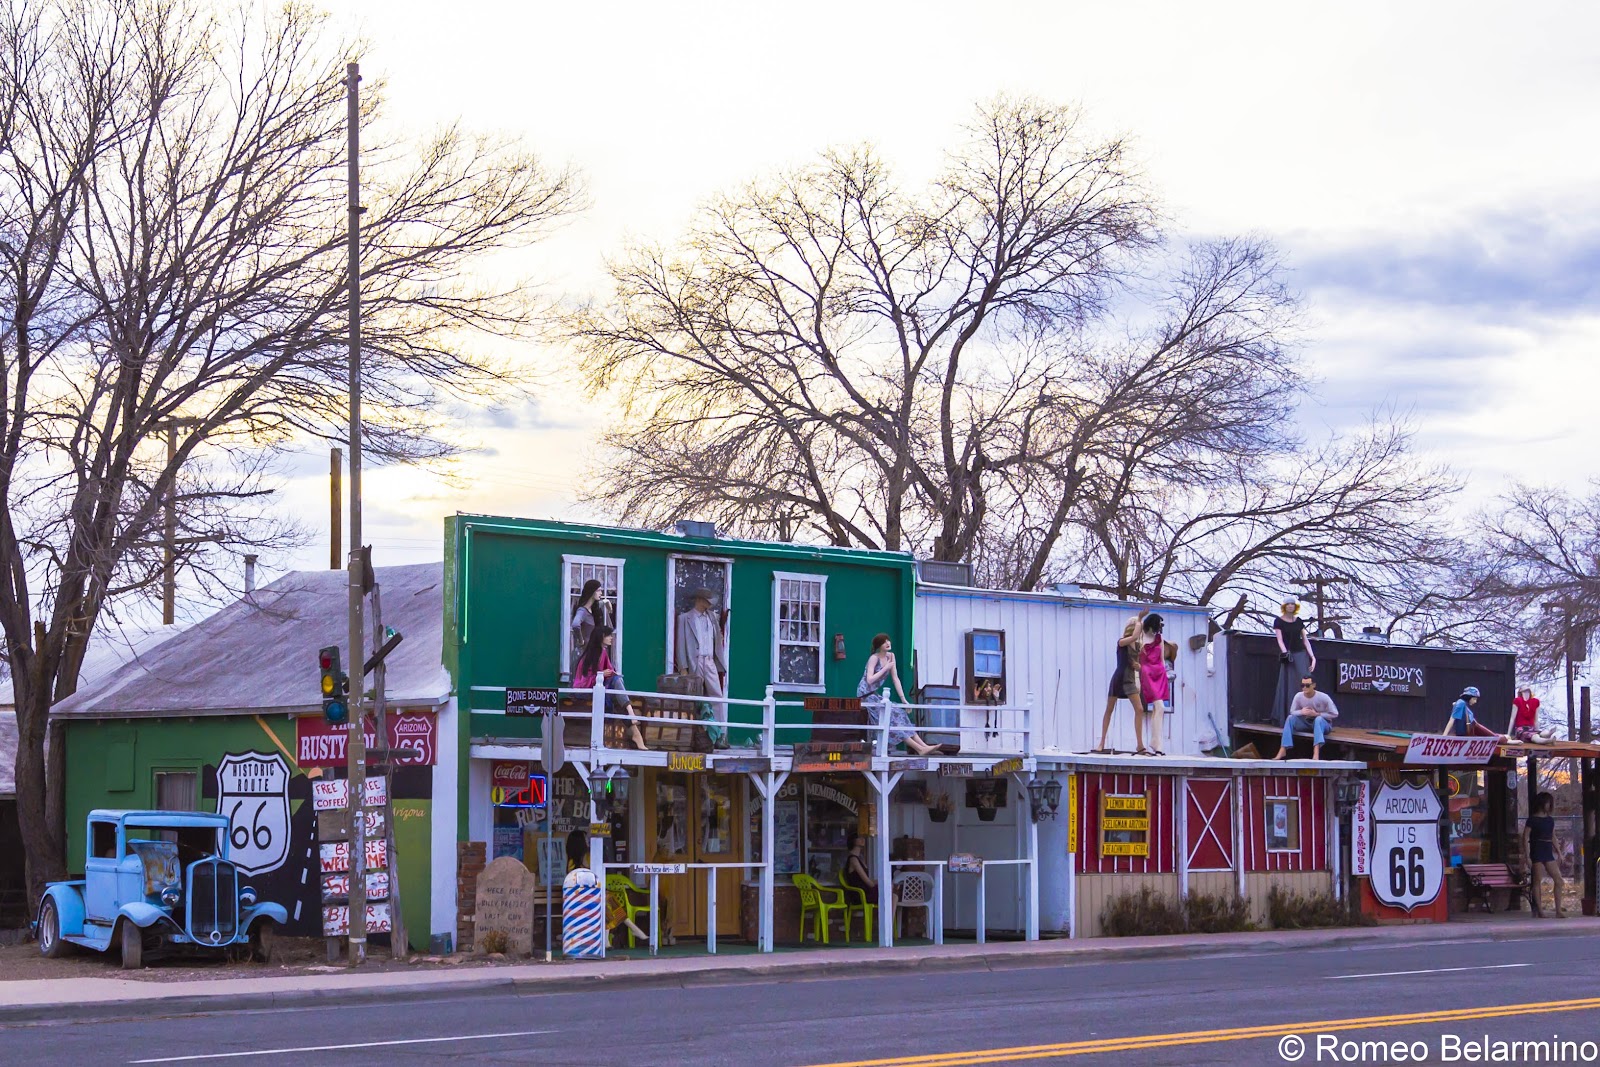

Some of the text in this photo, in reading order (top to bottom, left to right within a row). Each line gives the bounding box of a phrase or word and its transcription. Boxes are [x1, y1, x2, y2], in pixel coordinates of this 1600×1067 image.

[1340, 663, 1423, 687] BONE DADDY'S
[1351, 682, 1409, 692] OUTLET STORE
[507, 690, 557, 704] BONE DADDY'S
[398, 723, 427, 733] ARIZONA
[300, 734, 348, 760] RUSTY
[1411, 736, 1427, 748] The
[1422, 738, 1498, 757] RUSTY BOLT
[669, 752, 705, 771] JUNQUE
[232, 763, 275, 777] HISTORIC
[237, 778, 269, 792] ROUTE
[315, 782, 338, 795] FREE
[364, 780, 381, 792] REE
[316, 798, 345, 808] COFFEE
[1385, 798, 1429, 814] ARIZONA
[230, 800, 272, 850] 66
[1461, 818, 1472, 832] 66
[1397, 826, 1417, 844] US
[320, 853, 387, 872] WELME
[1389, 846, 1425, 897] 66
